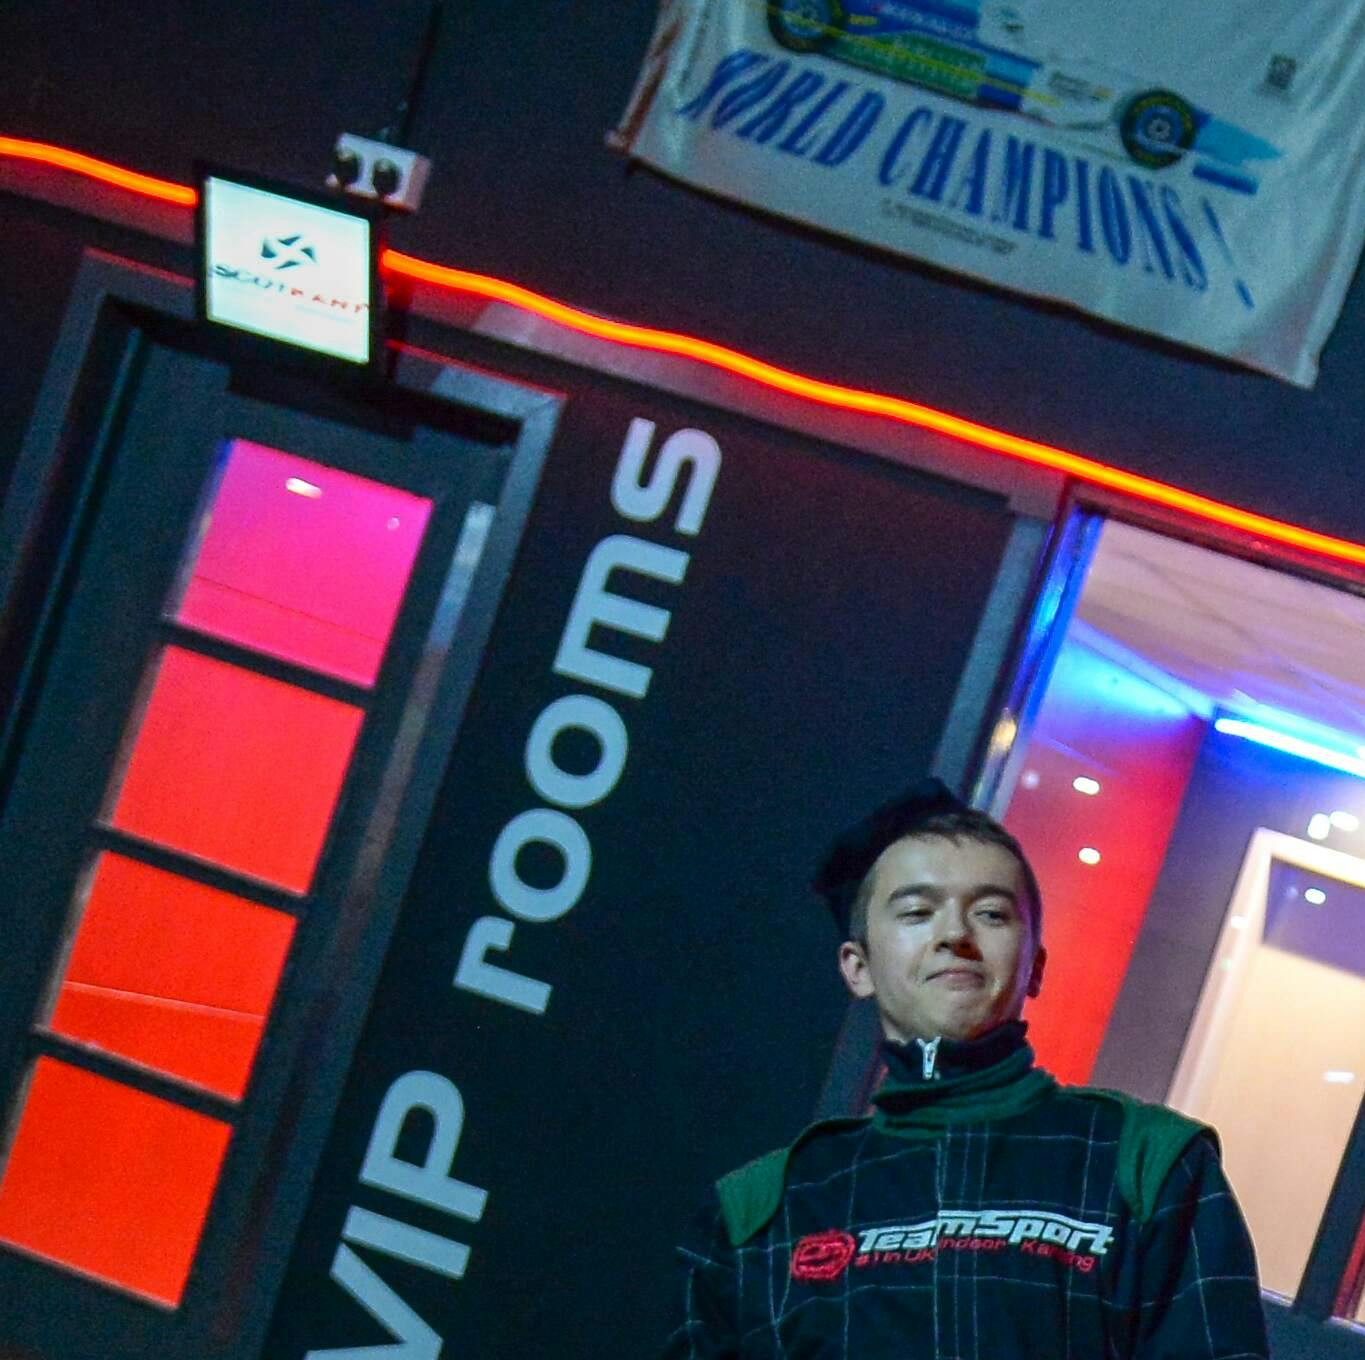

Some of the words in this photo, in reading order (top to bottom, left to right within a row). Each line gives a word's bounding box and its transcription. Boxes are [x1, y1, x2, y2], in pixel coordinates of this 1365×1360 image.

[679, 49, 883, 169] WORLD
[453, 416, 722, 1015] rooms
[857, 1209, 1115, 1254] TeamSport
